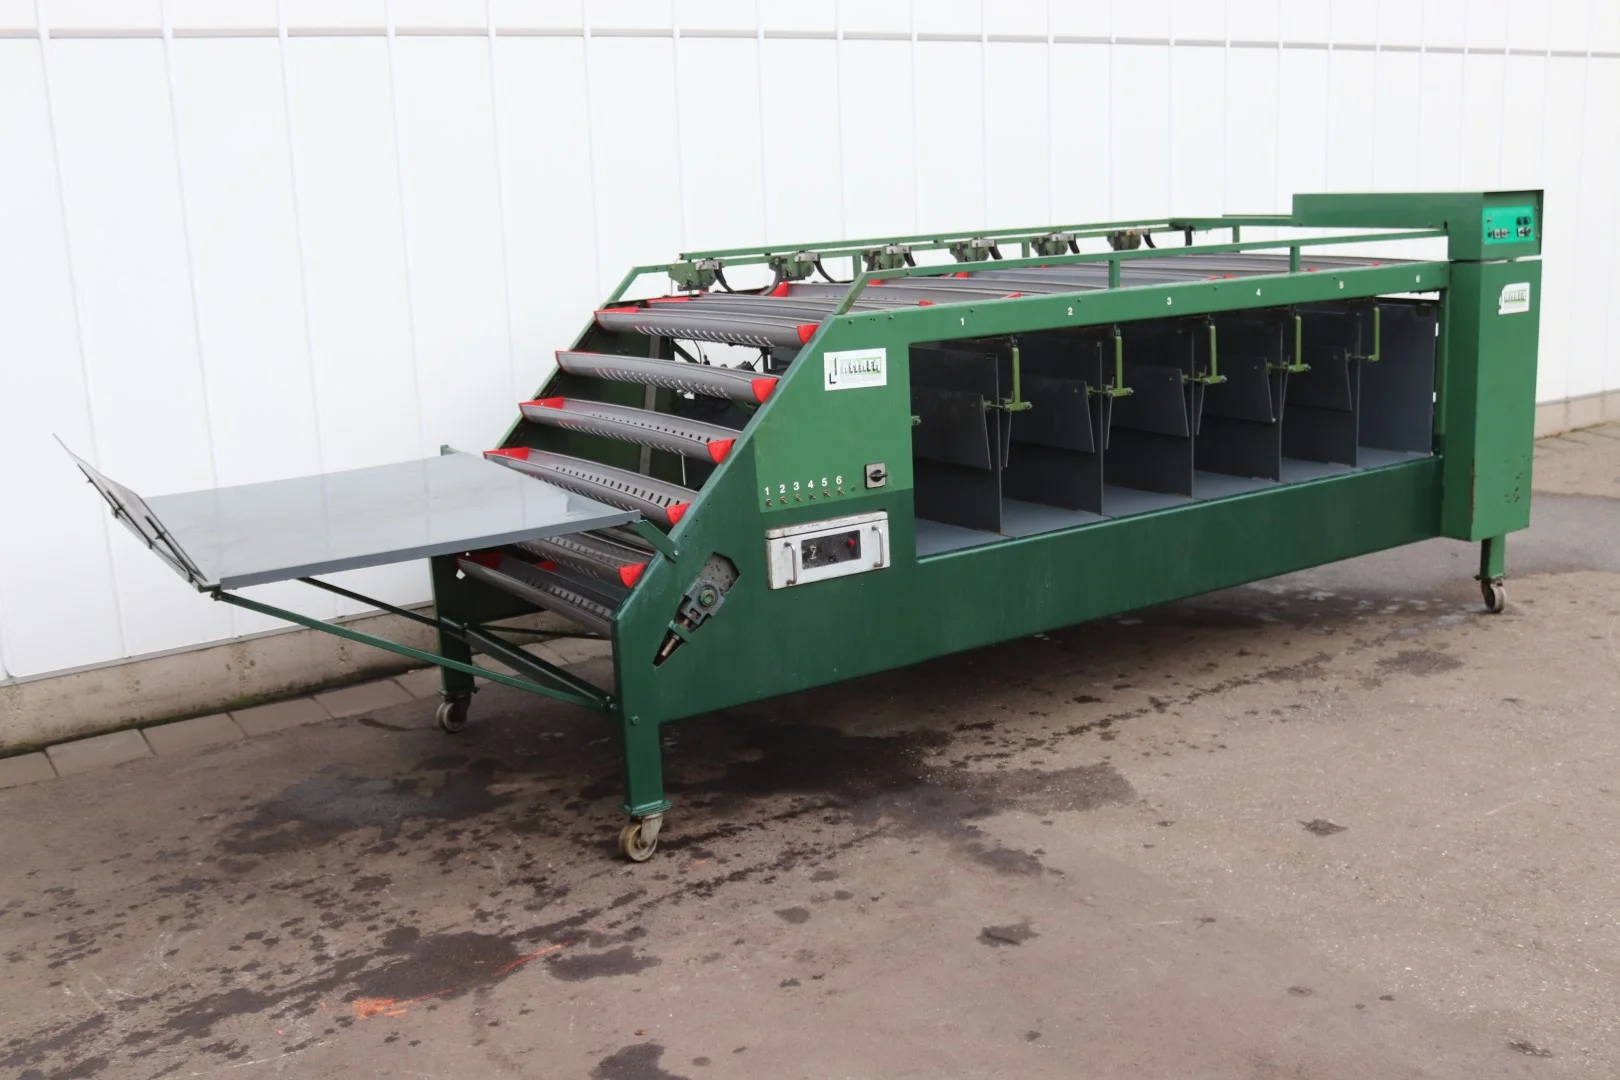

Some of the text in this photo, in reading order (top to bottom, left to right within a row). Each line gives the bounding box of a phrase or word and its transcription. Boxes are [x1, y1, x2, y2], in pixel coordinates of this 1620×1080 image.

[1339, 280, 1344, 290] 5
[1255, 288, 1261, 297] 4
[1166, 296, 1173, 306] 3
[1067, 306, 1074, 316] 2
[960, 317, 965, 326] 1
[764, 475, 842, 496] 1 2 3 4 5 6
